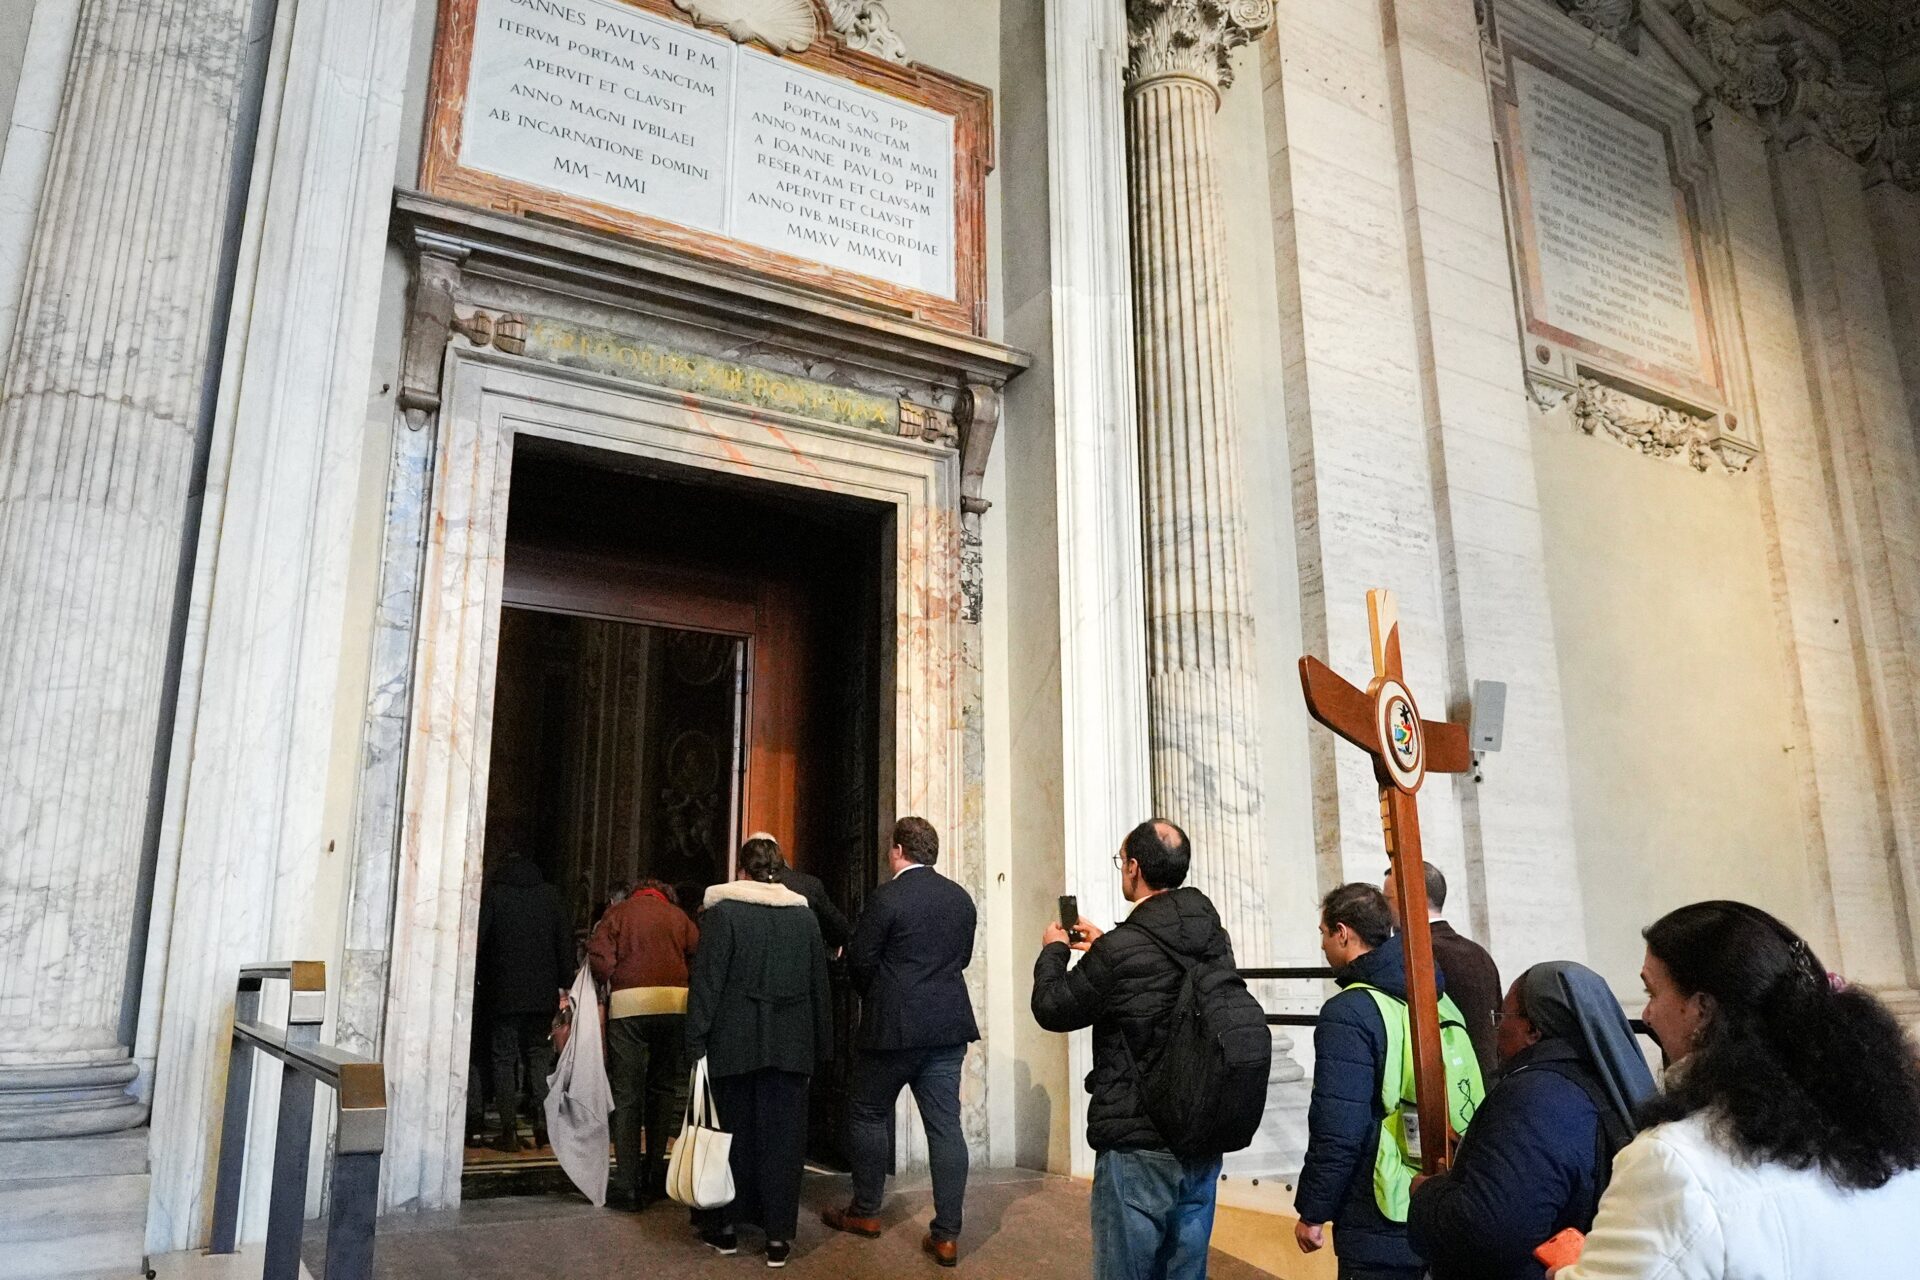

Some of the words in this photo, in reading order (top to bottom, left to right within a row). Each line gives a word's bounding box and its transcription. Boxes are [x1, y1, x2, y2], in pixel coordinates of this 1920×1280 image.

[511, 0, 586, 26] ANNES
[596, 18, 660, 50] PAVLVS
[668, 42, 678, 56] II
[498, 18, 559, 46] ITERVM
[568, 40, 634, 70] PORTAM
[642, 64, 715, 97] SANCTAM
[523, 57, 594, 86] APERVIT
[600, 79, 618, 94] ET
[624, 87, 687, 115] CLAVSIT
[510, 83, 563, 106] ANNO
[569, 100, 625, 126] MAGNI
[633, 119, 695, 147] IVBILAEI
[783, 101, 840, 128] PORTAM
[847, 122, 910, 152] SANCTAM
[785, 81, 879, 123] FRANCISCVS
[488, 108, 510, 122] AB
[517, 114, 643, 161] INCARNATIONE
[651, 153, 709, 180] DOMINI
[752, 112, 796, 133] ANNO
[800, 127, 846, 149] MAGNI
[910, 162, 937, 179] MMI
[755, 134, 763, 144] A
[774, 137, 835, 167] IOANNE
[844, 159, 894, 185] PAVLO
[757, 153, 844, 189] RESERATAM
[850, 182, 865, 195] ET
[870, 188, 931, 216] CLAVSAM
[776, 180, 835, 205] APERVIT
[839, 198, 855, 211] ET
[860, 205, 914, 229] CLAVSIT
[747, 192, 794, 213] ANNO
[828, 214, 939, 256] MISERICORDIAE
[787, 223, 840, 248] MMXV
[847, 240, 902, 267] MMXVI
